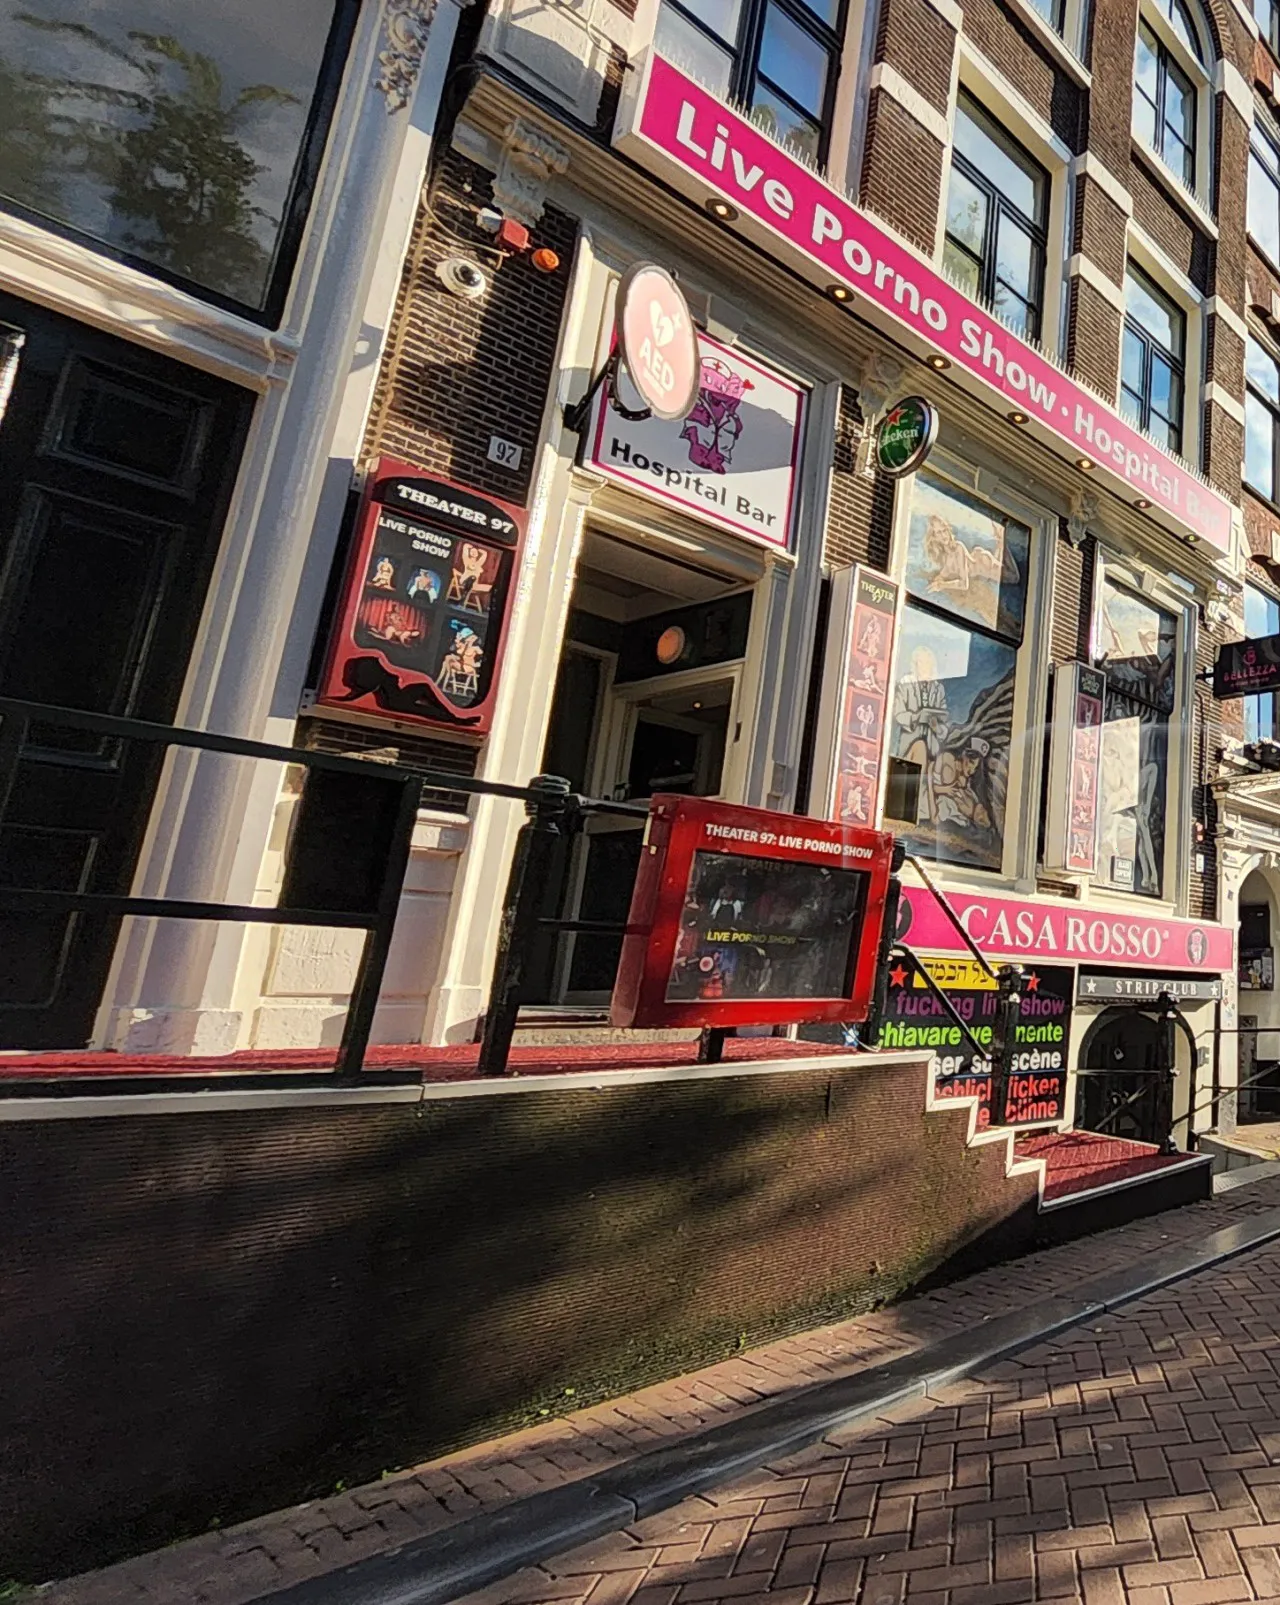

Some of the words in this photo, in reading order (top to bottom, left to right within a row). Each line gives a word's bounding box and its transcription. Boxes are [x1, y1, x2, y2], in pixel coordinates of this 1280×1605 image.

[676, 101, 794, 220] Live
[811, 203, 947, 331] Porno
[960, 318, 1057, 412] Show
[1074, 404, 1180, 504] Hospital
[1186, 489, 1222, 531] Bar
[638, 336, 675, 392] AED
[496, 442, 517, 464] 97
[610, 437, 727, 506] Hospital
[735, 495, 777, 527] Bar
[397, 484, 487, 526] THEATER
[491, 518, 514, 534] 97
[379, 516, 406, 533] LIVE
[408, 524, 452, 548] PORNO
[412, 539, 450, 559] SHOW
[861, 580, 894, 601] THEATER
[1223, 664, 1277, 682] BELLEZZA
[706, 823, 758, 843] THEATER
[760, 832, 777, 846] 97:
[779, 835, 802, 849] LIVE
[804, 838, 841, 855] PORNO
[843, 846, 874, 859] SHOW
[707, 931, 731, 942] LIVE
[960, 904, 1058, 950] CASA
[1115, 980, 1158, 995] STRIP
[1163, 981, 1198, 996] CLUB
[1020, 993, 1065, 1016] show
[1010, 1048, 1062, 1072] scène
